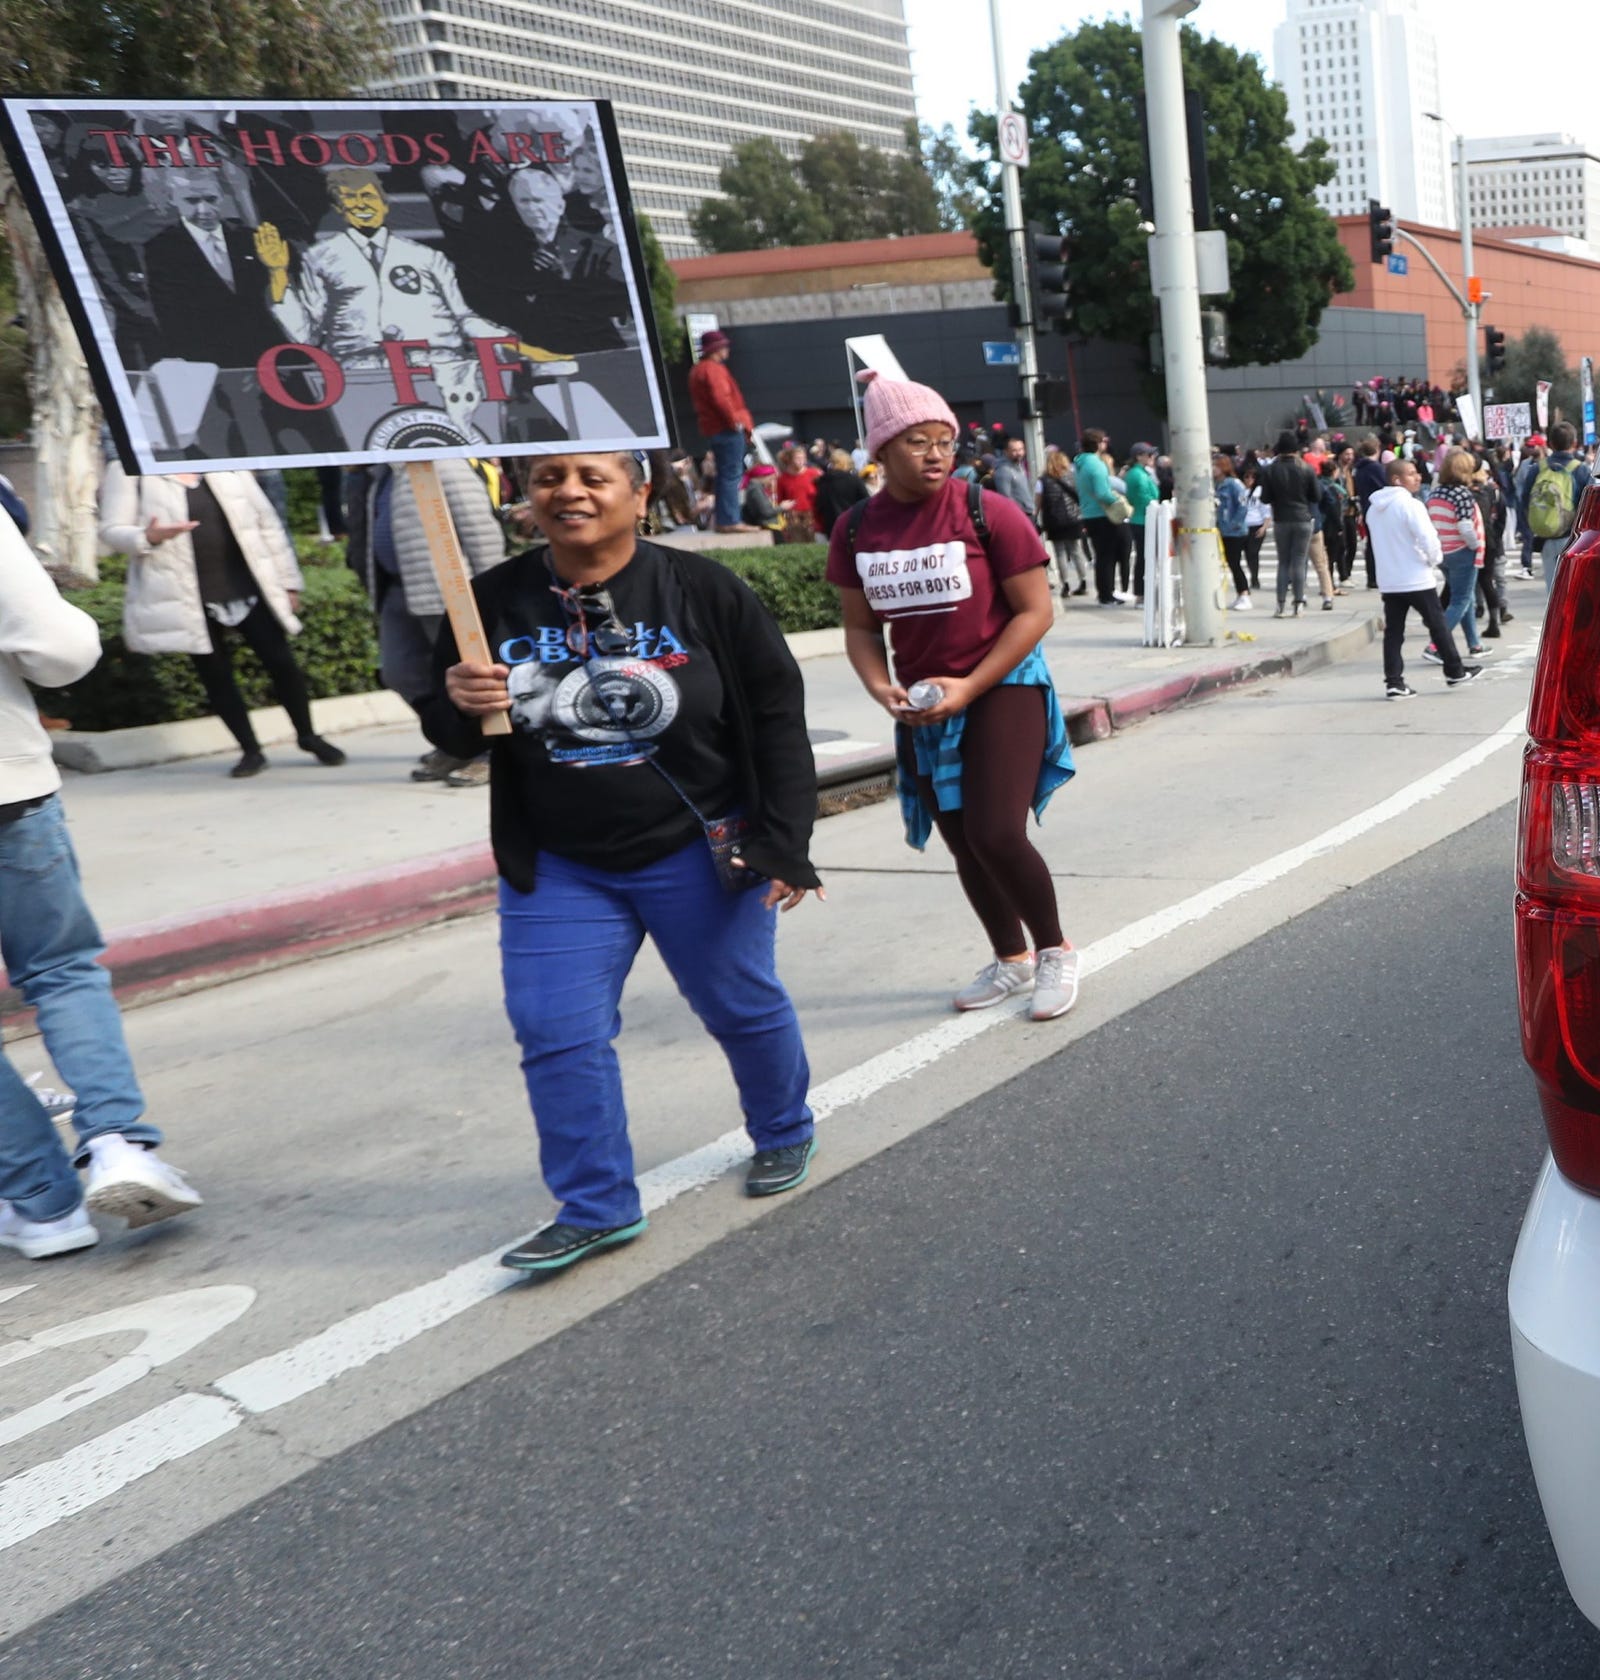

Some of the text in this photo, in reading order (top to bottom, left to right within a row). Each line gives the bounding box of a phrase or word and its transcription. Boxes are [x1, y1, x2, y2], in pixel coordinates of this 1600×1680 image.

[88, 129, 570, 168] THE HOODS ARE
[868, 554, 945, 577] GIRLS DO NOT
[898, 580, 924, 598] FOR
[925, 575, 961, 594] BOYS
